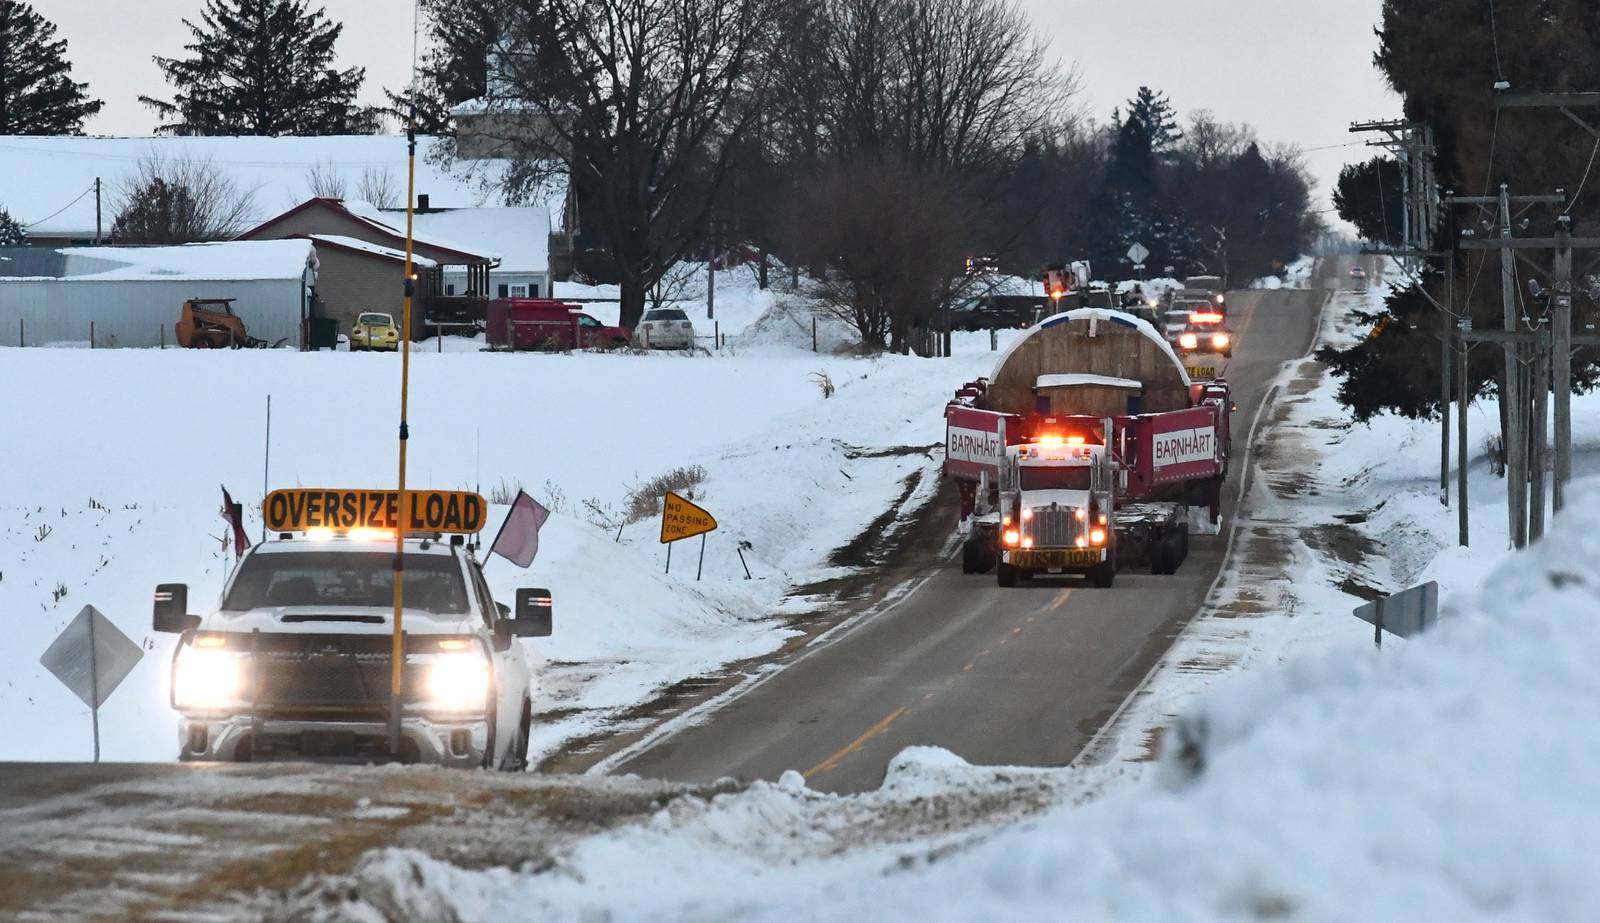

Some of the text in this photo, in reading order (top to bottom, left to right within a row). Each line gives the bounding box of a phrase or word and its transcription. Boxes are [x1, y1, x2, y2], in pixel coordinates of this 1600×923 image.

[1197, 367, 1215, 377] LOAD
[952, 432, 999, 461] BARNHAR
[1156, 428, 1211, 464] BARNHART
[270, 492, 480, 529] OVERSIZE LOAD
[667, 503, 681, 512] NO
[666, 514, 708, 527] PASSING
[665, 524, 686, 534] ZONE
